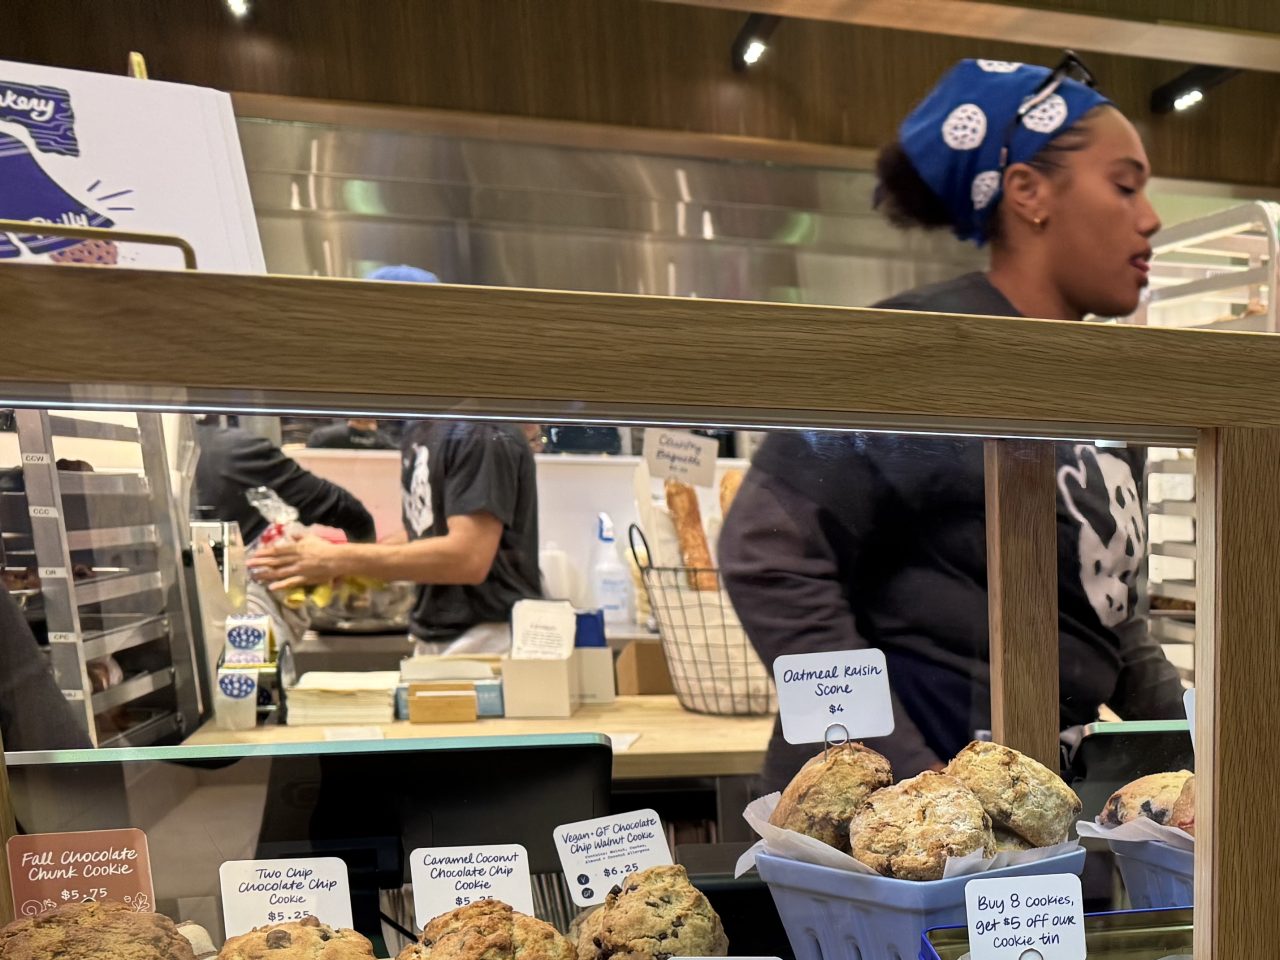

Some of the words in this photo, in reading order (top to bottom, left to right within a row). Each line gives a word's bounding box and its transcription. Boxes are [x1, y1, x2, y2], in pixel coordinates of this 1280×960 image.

[783, 666, 839, 683] Oatmeal
[844, 664, 882, 678] Raisin
[815, 683, 853, 696] Scone
[829, 704, 844, 714] $4
[562, 831, 590, 844] Vegan
[595, 825, 611, 837] GF
[612, 817, 657, 834] Chocolate
[570, 842, 592, 855] Chip
[594, 836, 625, 849] Walnut
[627, 831, 655, 843] Cookie
[21, 851, 55, 867] Fall
[60, 847, 138, 864] Chocolate
[423, 853, 475, 866] Caramel
[475, 851, 519, 864] Coconut
[28, 866, 78, 881] Chunk
[83, 863, 133, 878] Cookie
[255, 868, 282, 880] Two
[286, 867, 313, 880] Chip
[430, 866, 486, 879] Chocolate
[489, 865, 513, 878] Chip
[603, 863, 639, 878] $6.25
[238, 879, 305, 893] Chocolate
[308, 879, 337, 891] Chip
[455, 879, 491, 891] Cookie
[61, 887, 108, 901] $5.75
[269, 893, 306, 905] Cookie
[977, 896, 1005, 914] Buy
[1010, 893, 1020, 908] 8
[1025, 894, 1074, 908] cookies,
[268, 910, 310, 922] $5.25
[975, 919, 1000, 935] get
[1003, 916, 1021, 930] $5
[1026, 913, 1049, 928] off
[1052, 915, 1076, 926] our
[993, 935, 1035, 948] cookie
[1039, 932, 1060, 945] tin
